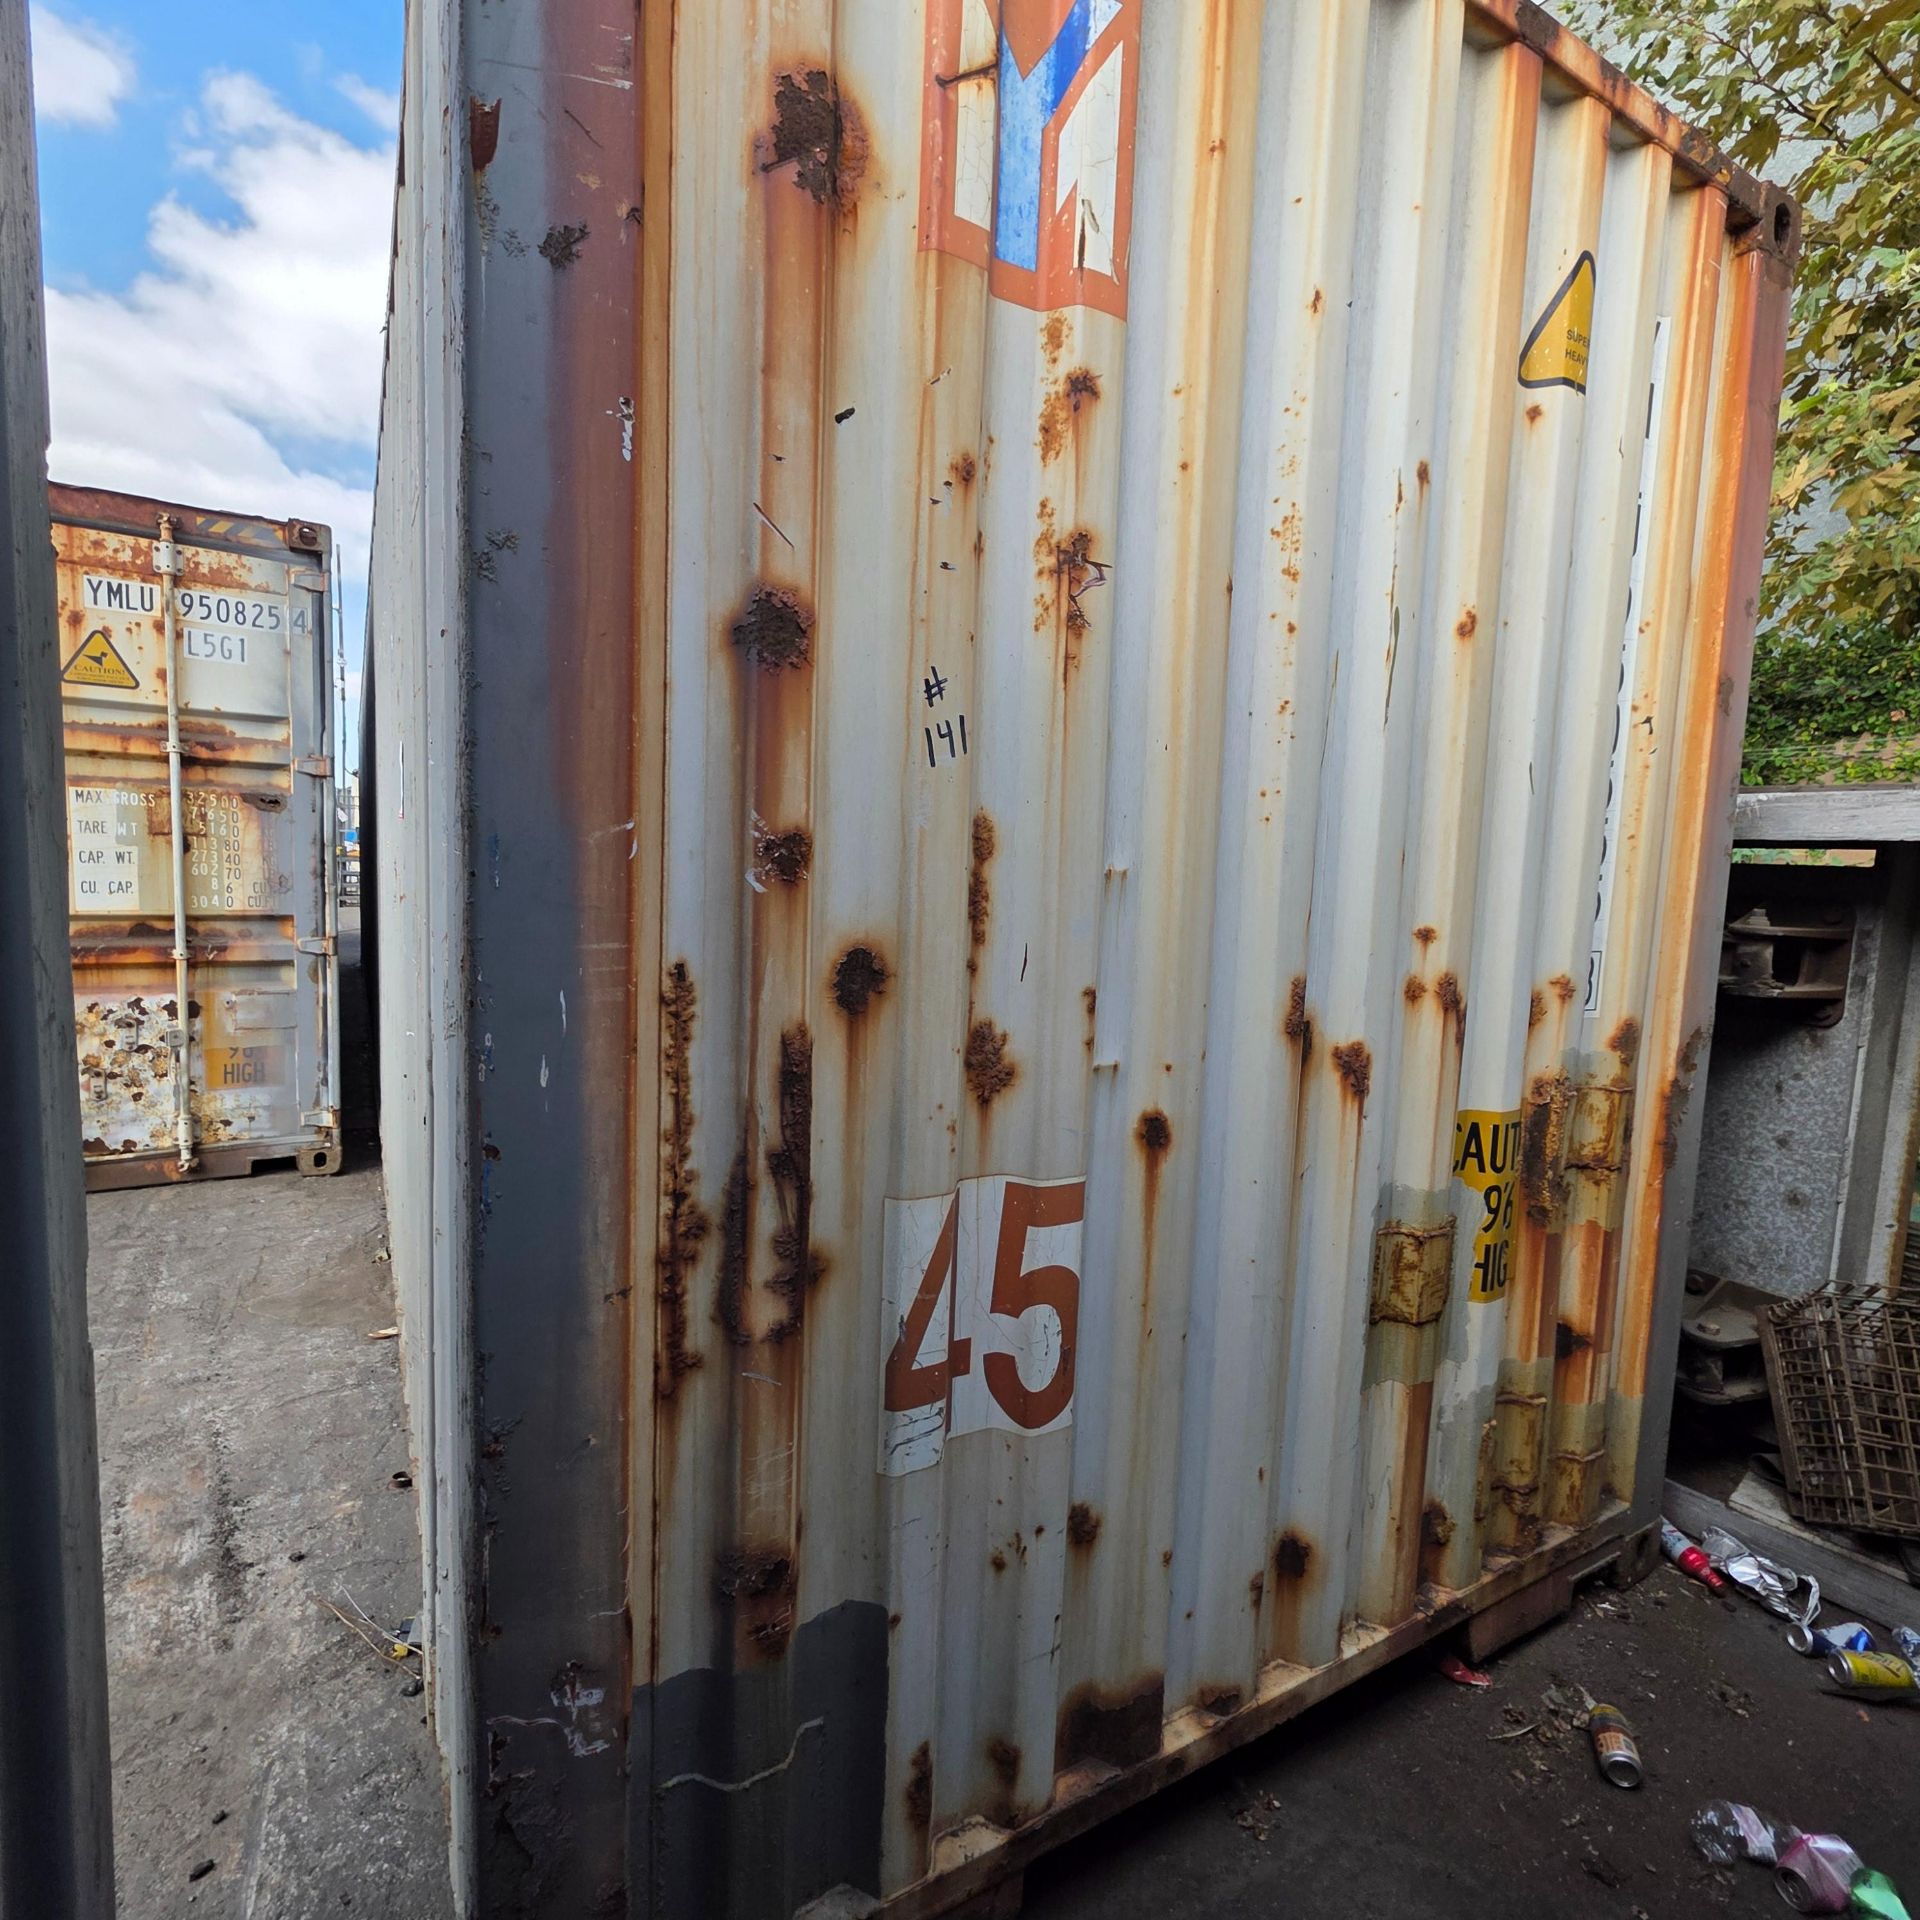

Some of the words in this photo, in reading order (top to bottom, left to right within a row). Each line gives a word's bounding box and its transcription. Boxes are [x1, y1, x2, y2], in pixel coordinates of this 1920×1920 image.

[87, 578, 155, 613] YMLU
[181, 592, 281, 630] 950825
[293, 608, 307, 634] 4
[187, 630, 246, 663] L5G1
[923, 665, 949, 708] #
[924, 714, 968, 768] 141
[75, 789, 102, 803] MAX
[77, 820, 107, 834] TARE
[223, 1062, 265, 1085] HIGH
[884, 1180, 1087, 1431] 45
